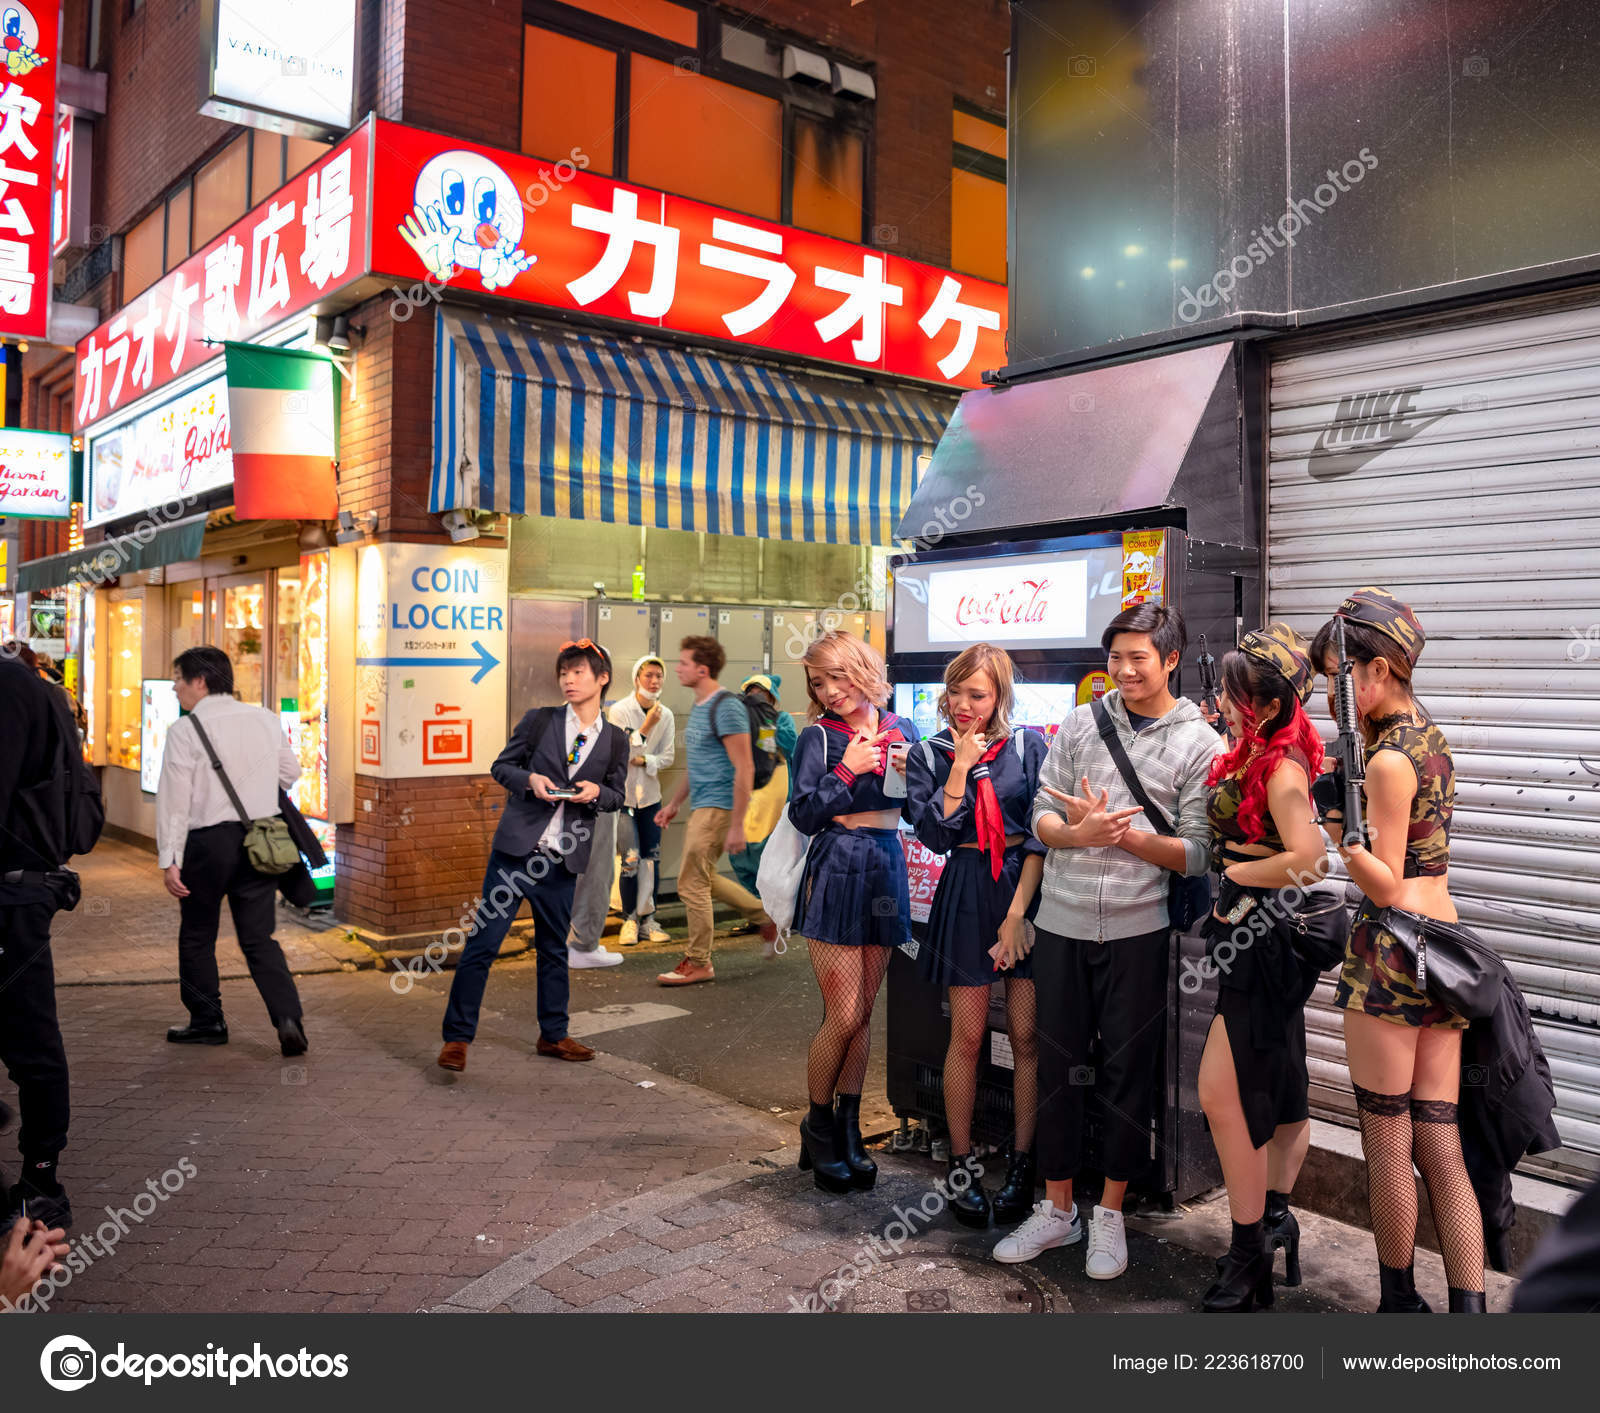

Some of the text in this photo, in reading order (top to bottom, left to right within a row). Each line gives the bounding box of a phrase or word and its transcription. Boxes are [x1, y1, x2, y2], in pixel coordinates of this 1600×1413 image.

[78, 148, 354, 425] カラオケ歌広場
[565, 187, 1001, 380] カラオケ
[1326, 385, 1424, 444] NIKE
[1128, 540, 1147, 549] Coke
[411, 566, 479, 593] COIN
[391, 603, 504, 631] LOCKER
[906, 843, 946, 868] ためる
[1417, 951, 1425, 980] SCARLET
